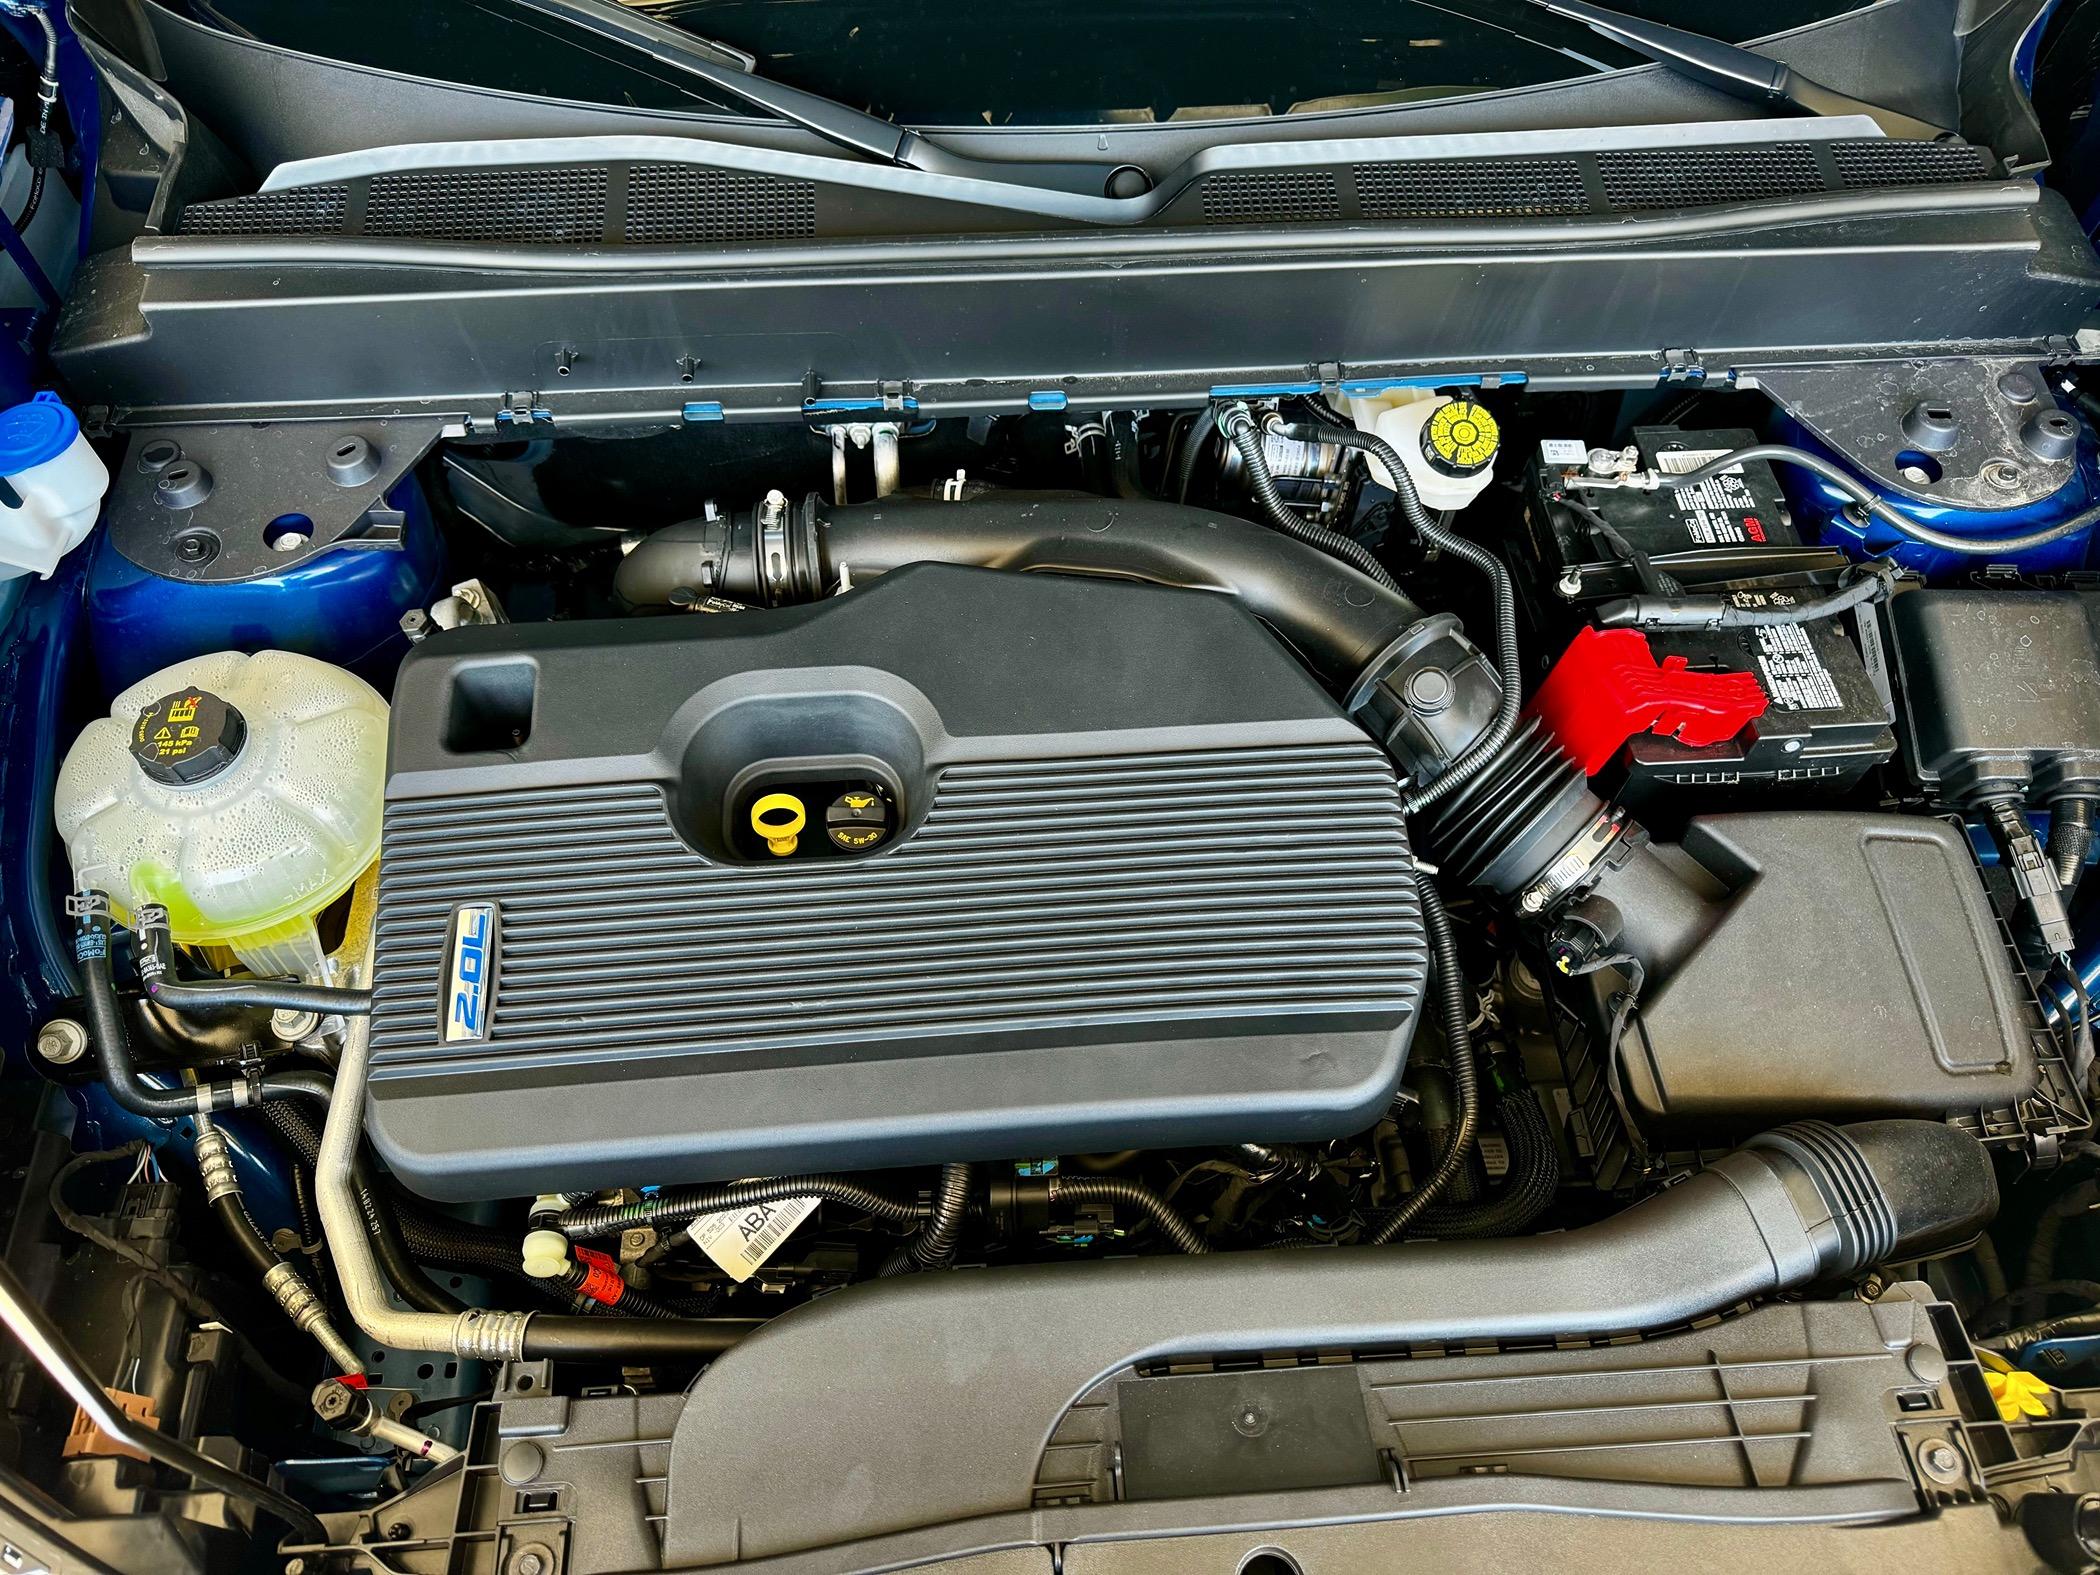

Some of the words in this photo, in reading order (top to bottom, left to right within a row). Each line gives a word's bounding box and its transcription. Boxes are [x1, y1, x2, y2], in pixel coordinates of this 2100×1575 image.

[1743, 517, 1762, 543] AGM
[157, 740, 174, 748] 145
[175, 739, 193, 747] kPa
[158, 748, 171, 756] 21
[172, 747, 187, 756] psi
[837, 831, 851, 844] SAE
[853, 831, 878, 845] 5W-30
[292, 868, 332, 897] MAX
[454, 914, 486, 1030] 2.0L
[738, 1204, 777, 1242] ABA
